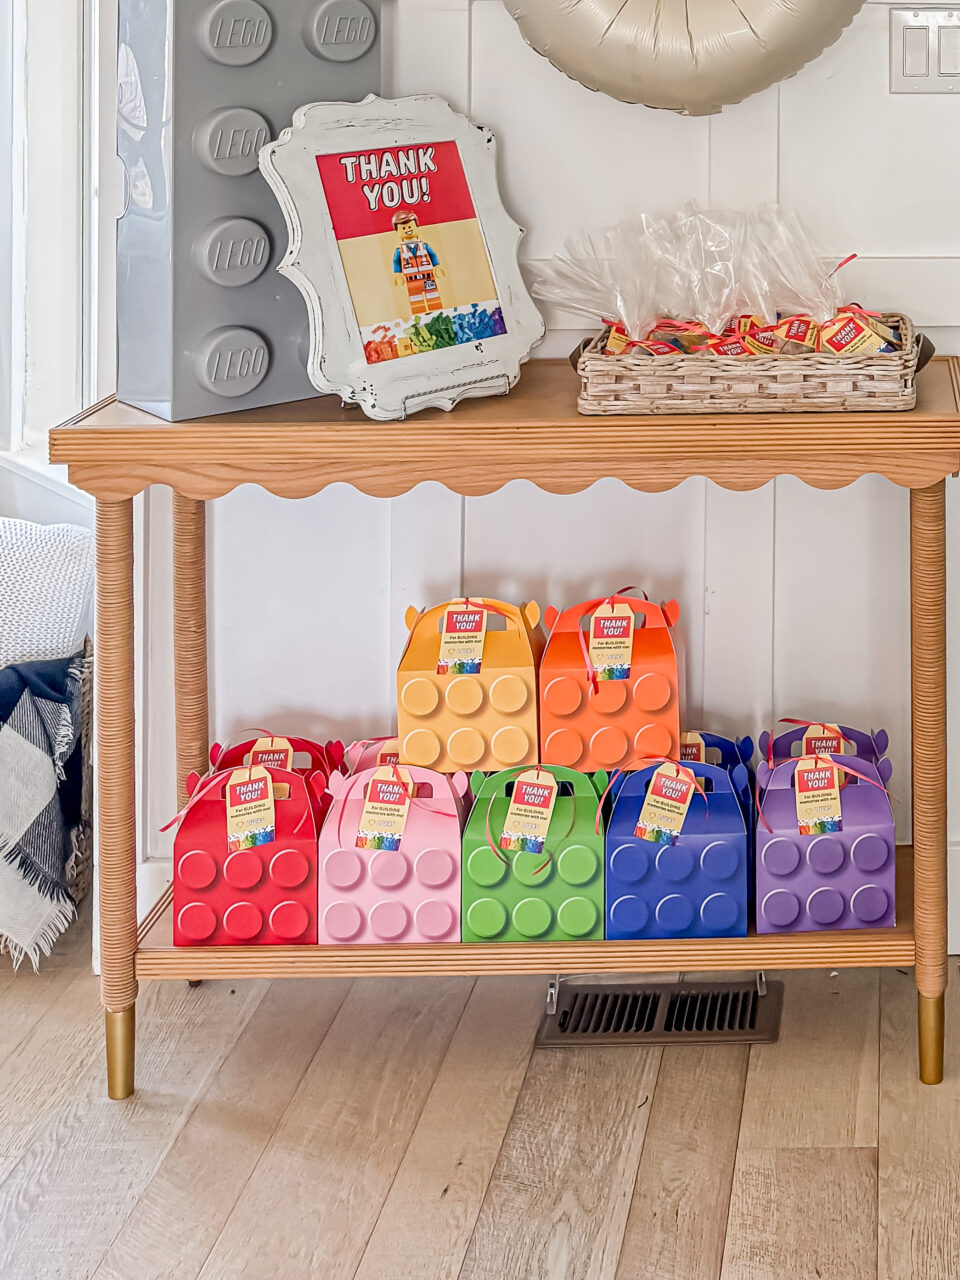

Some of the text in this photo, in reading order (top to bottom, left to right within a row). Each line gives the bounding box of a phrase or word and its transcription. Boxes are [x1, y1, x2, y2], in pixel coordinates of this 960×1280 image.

[213, 16, 268, 48] LEGO
[320, 15, 371, 45] LEGO
[213, 127, 267, 160] LEGO
[339, 145, 437, 183] THANK
[361, 176, 431, 211] YOU!
[212, 236, 266, 273] LEGO
[832, 322, 856, 343] THANK
[840, 330, 857, 344] YOU!
[210, 344, 265, 384] LEGO
[811, 740, 838, 748] THANK
[804, 770, 831, 780] THANK
[236, 781, 265, 795] THANK
[522, 785, 550, 797] THANK
[660, 778, 688, 793] THANK
[808, 780, 827, 788] YOU!
[240, 790, 260, 802] YOU!
[379, 792, 399, 801] YOU!
[524, 795, 544, 804] YOU!
[662, 787, 681, 799] YOU!
